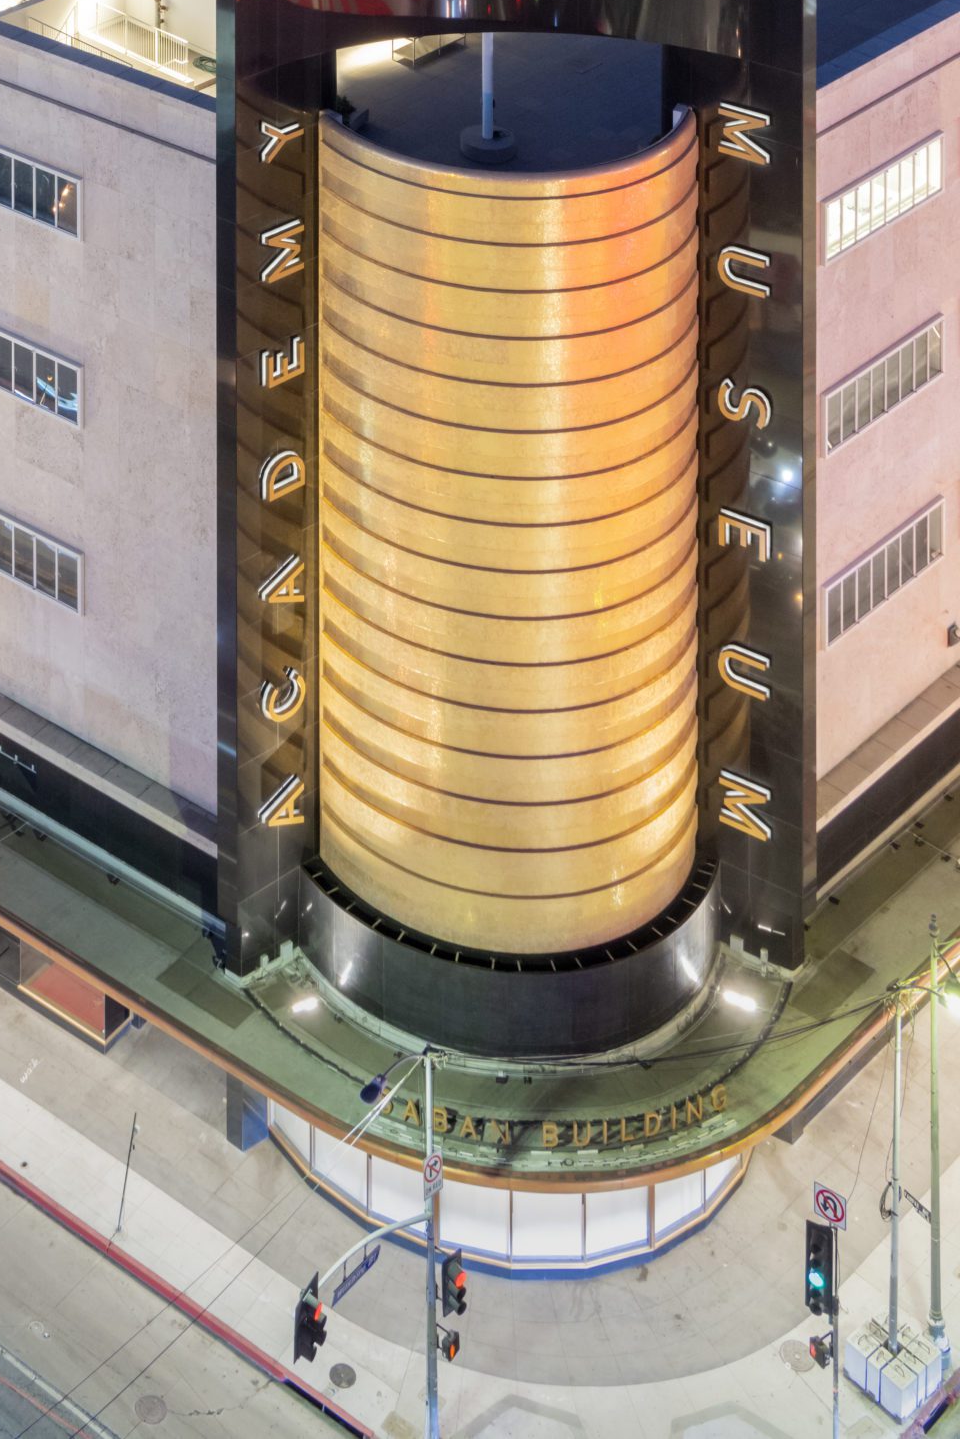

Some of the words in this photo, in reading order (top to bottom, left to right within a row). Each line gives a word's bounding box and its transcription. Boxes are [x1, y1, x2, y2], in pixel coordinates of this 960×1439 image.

[258, 121, 307, 829] ACADEMY
[717, 101, 772, 842] MUSEUM
[541, 1084, 728, 1148] BUILDING
